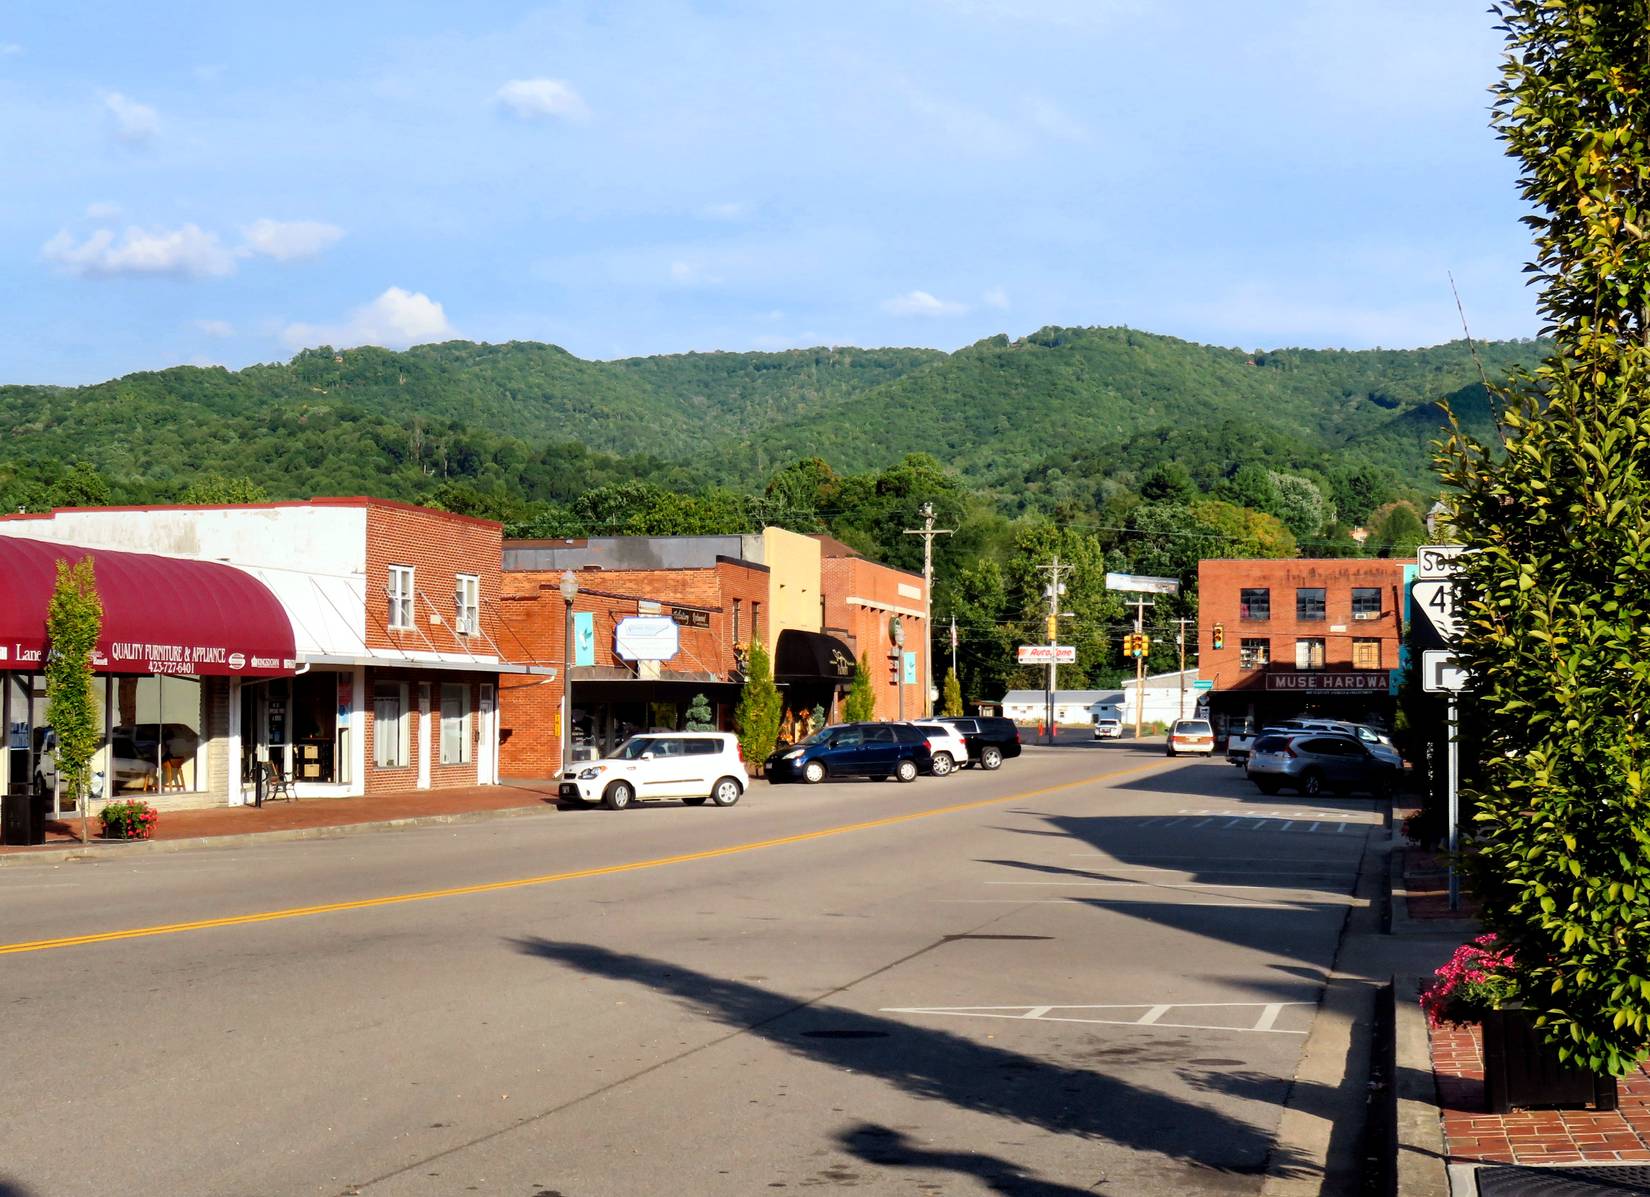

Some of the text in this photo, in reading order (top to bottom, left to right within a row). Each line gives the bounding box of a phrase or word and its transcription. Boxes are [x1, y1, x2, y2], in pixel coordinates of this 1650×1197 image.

[15, 643, 41, 661] Lane
[112, 642, 143, 660] QUALITY
[145, 643, 183, 662] FURNITURE
[184, 646, 191, 662] &
[192, 646, 226, 664] APPLIANCE
[148, 662, 195, 674] 423-727-6401
[1275, 676, 1387, 688] MUSE HARDWA
